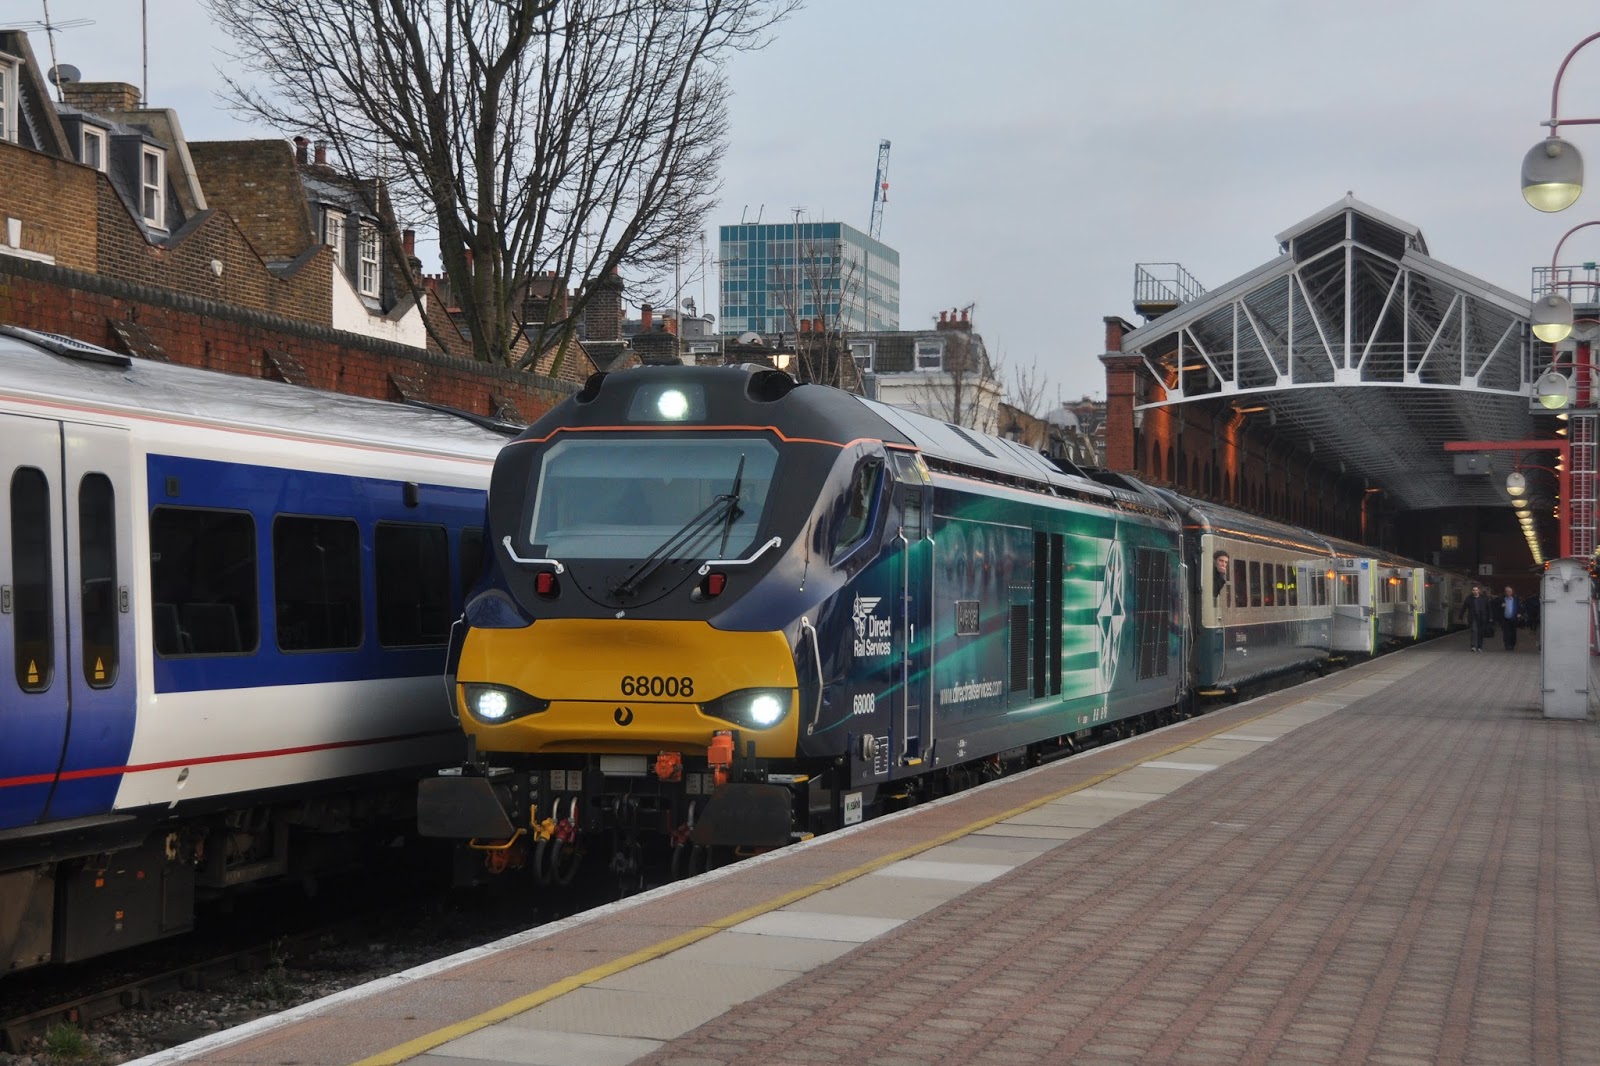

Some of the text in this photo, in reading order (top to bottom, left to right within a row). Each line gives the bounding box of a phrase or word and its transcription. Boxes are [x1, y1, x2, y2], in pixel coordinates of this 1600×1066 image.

[868, 614, 892, 637] Direct
[910, 623, 914, 644] 1
[854, 637, 891, 657] Rail Services
[621, 675, 694, 697] 68008
[940, 678, 1002, 705] www.directrailservices.com
[853, 693, 875, 715] 68008
